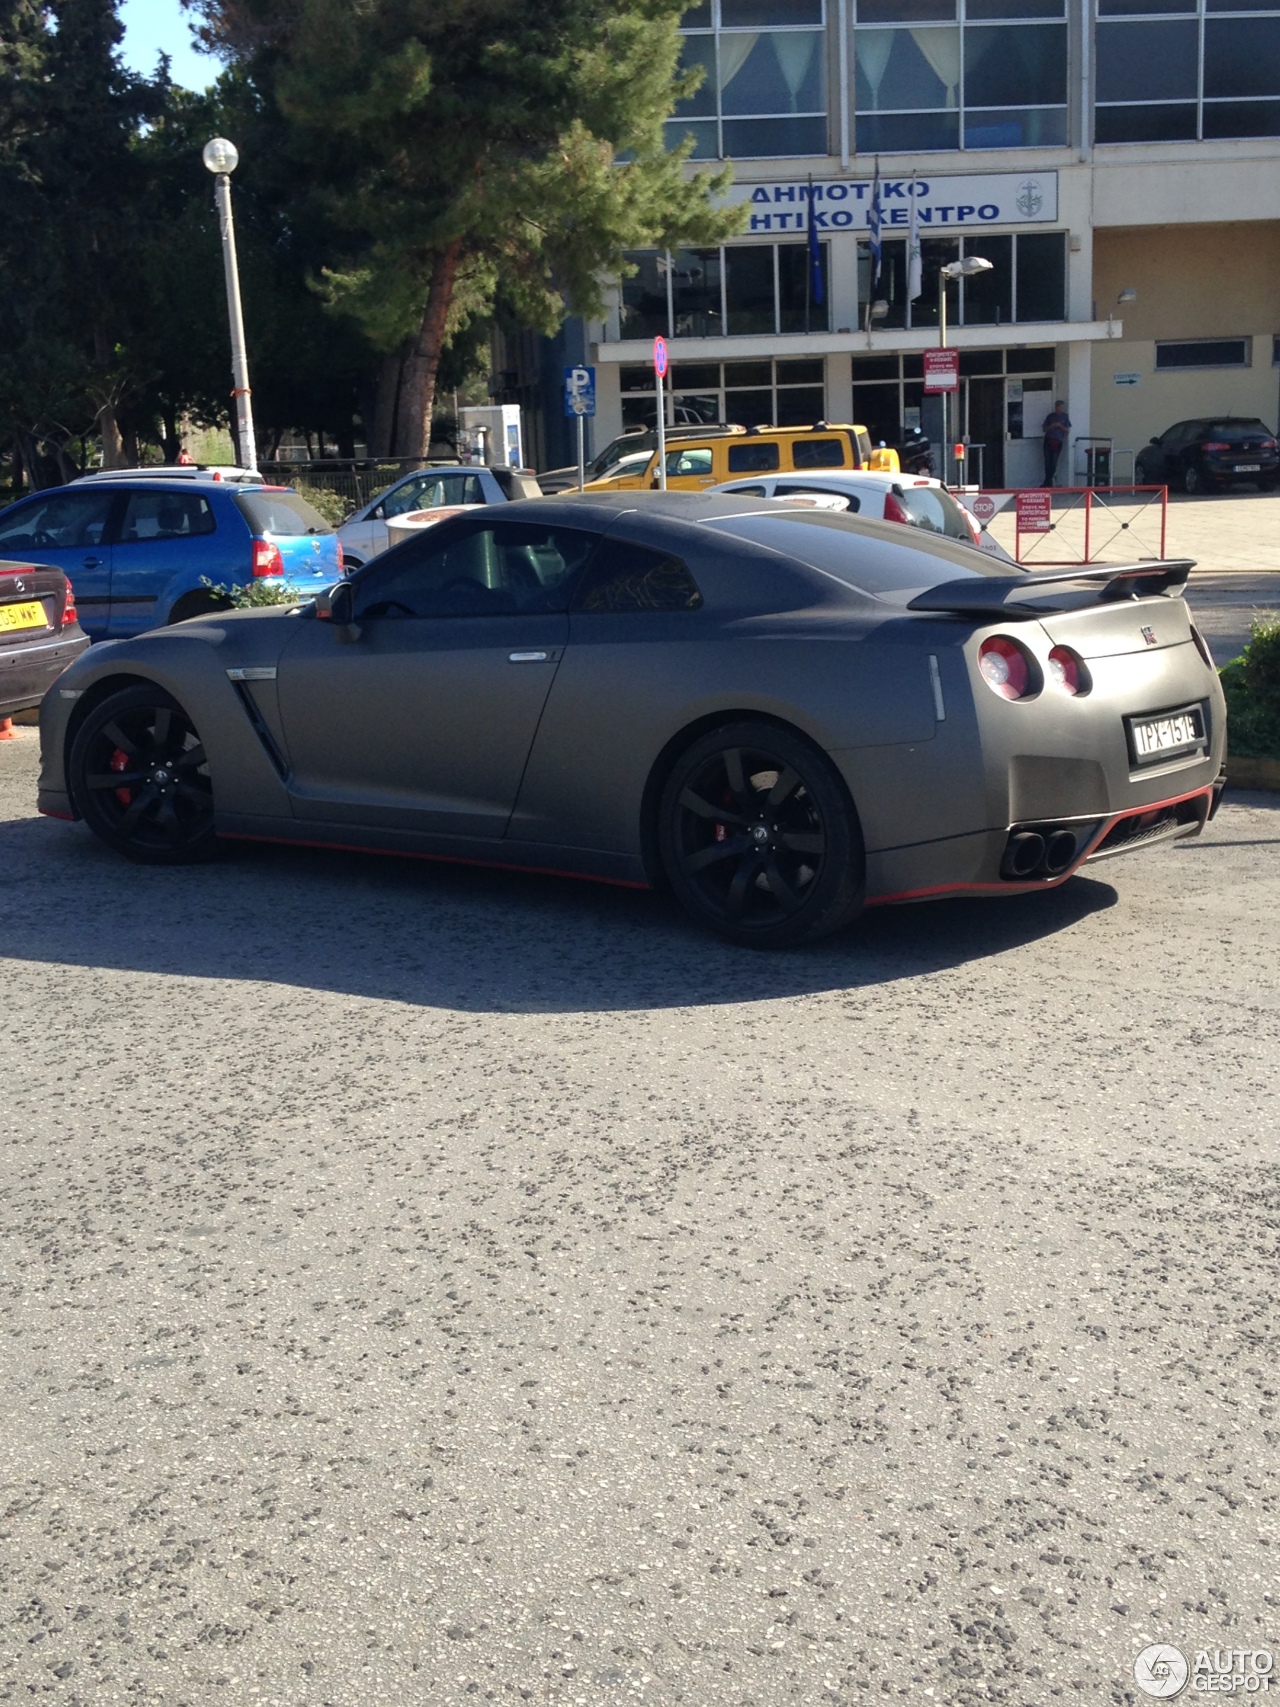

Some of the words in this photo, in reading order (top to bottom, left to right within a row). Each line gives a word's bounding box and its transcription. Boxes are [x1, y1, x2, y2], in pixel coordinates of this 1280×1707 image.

[751, 181, 930, 203] ΔΗΜΟΤΚΟ
[866, 204, 1000, 226] ΚΕΝΤΡΟ
[572, 369, 590, 396] P
[974, 503, 994, 512] STOP
